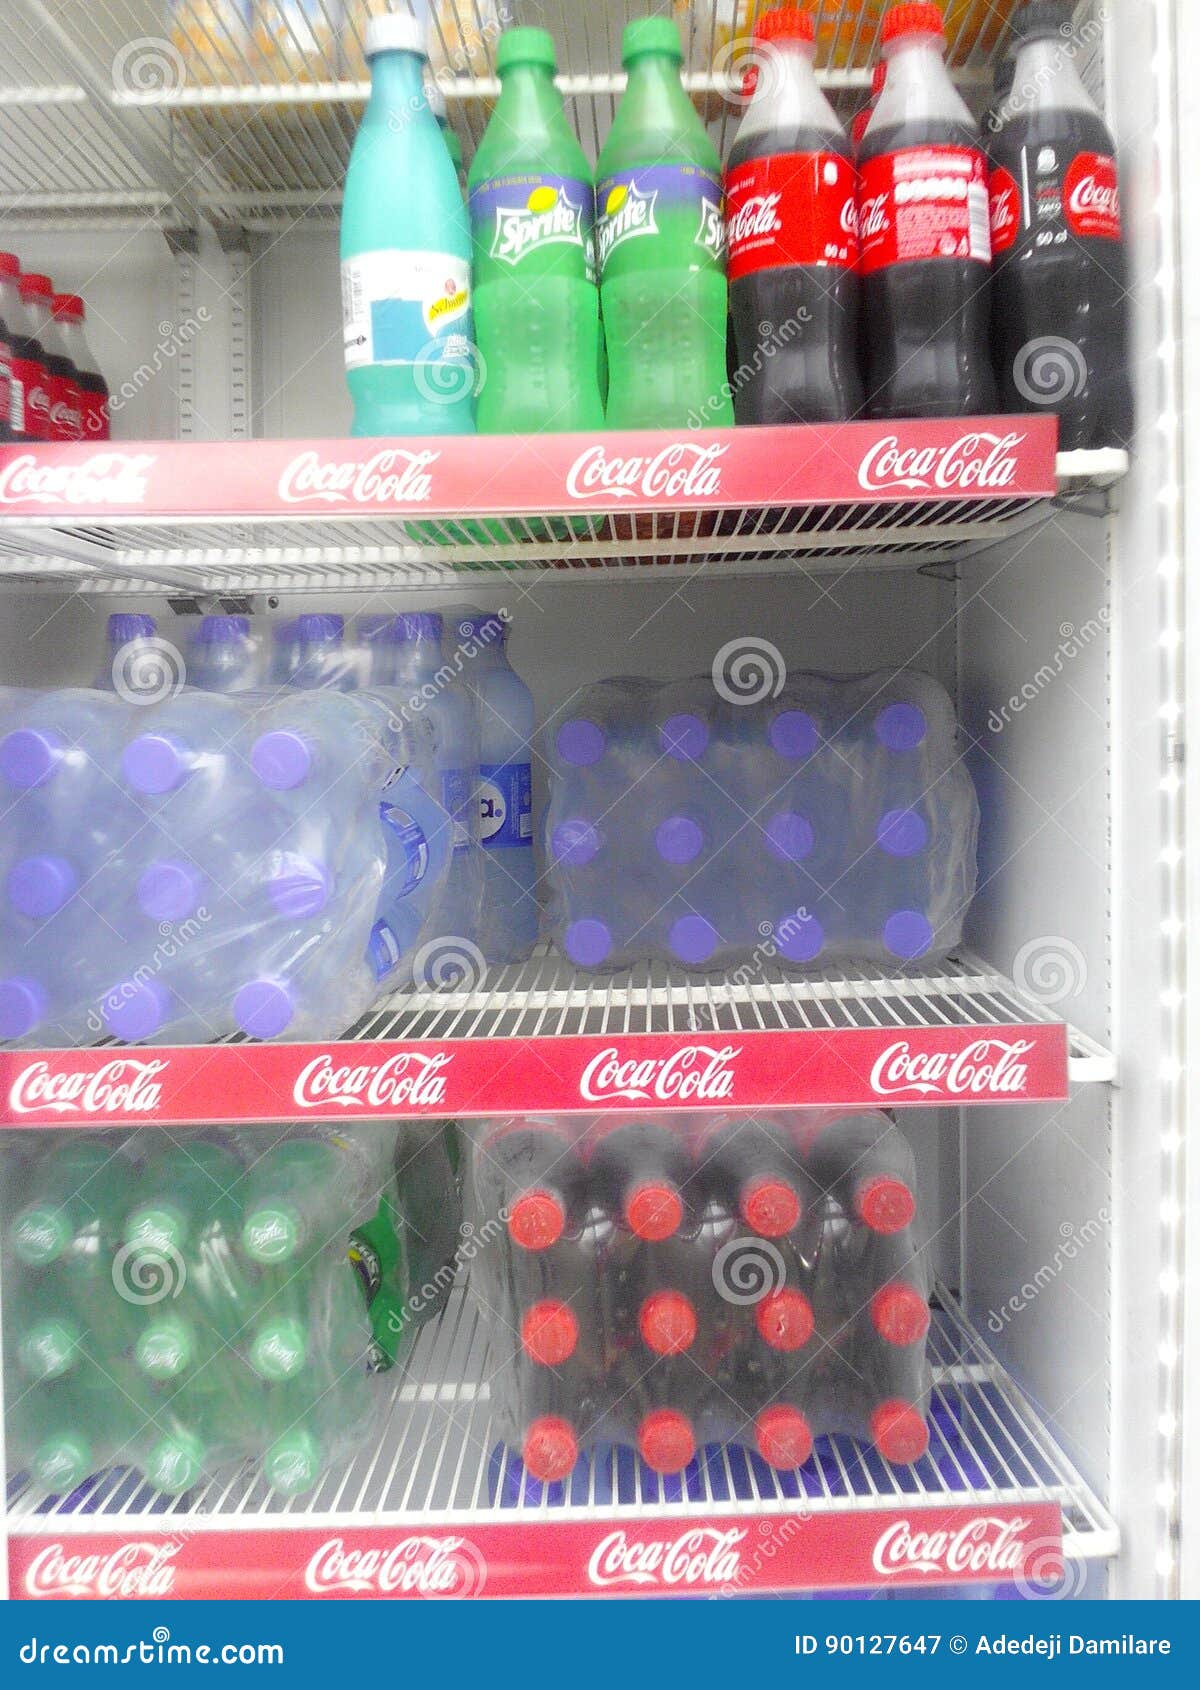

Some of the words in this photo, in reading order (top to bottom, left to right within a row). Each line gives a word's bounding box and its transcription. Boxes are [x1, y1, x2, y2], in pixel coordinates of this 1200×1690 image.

[499, 203, 575, 256] Sprite
[599, 198, 647, 261] prite
[278, 449, 441, 503] Coca-Cola
[565, 443, 730, 498] Coca-Cola
[857, 432, 1027, 490] Coca-Cola
[10, 1059, 170, 1113] Coca-Cola
[293, 1052, 454, 1108] Coca-Cola
[579, 1045, 743, 1101] Coca-Cola
[869, 1039, 1036, 1095] Coca-Cola
[24, 1542, 184, 1596] Coca-Cola
[305, 1535, 464, 1593] Coca-Cola
[587, 1527, 749, 1585] Coca-Cola
[872, 1517, 1032, 1576] Coca-Cola
